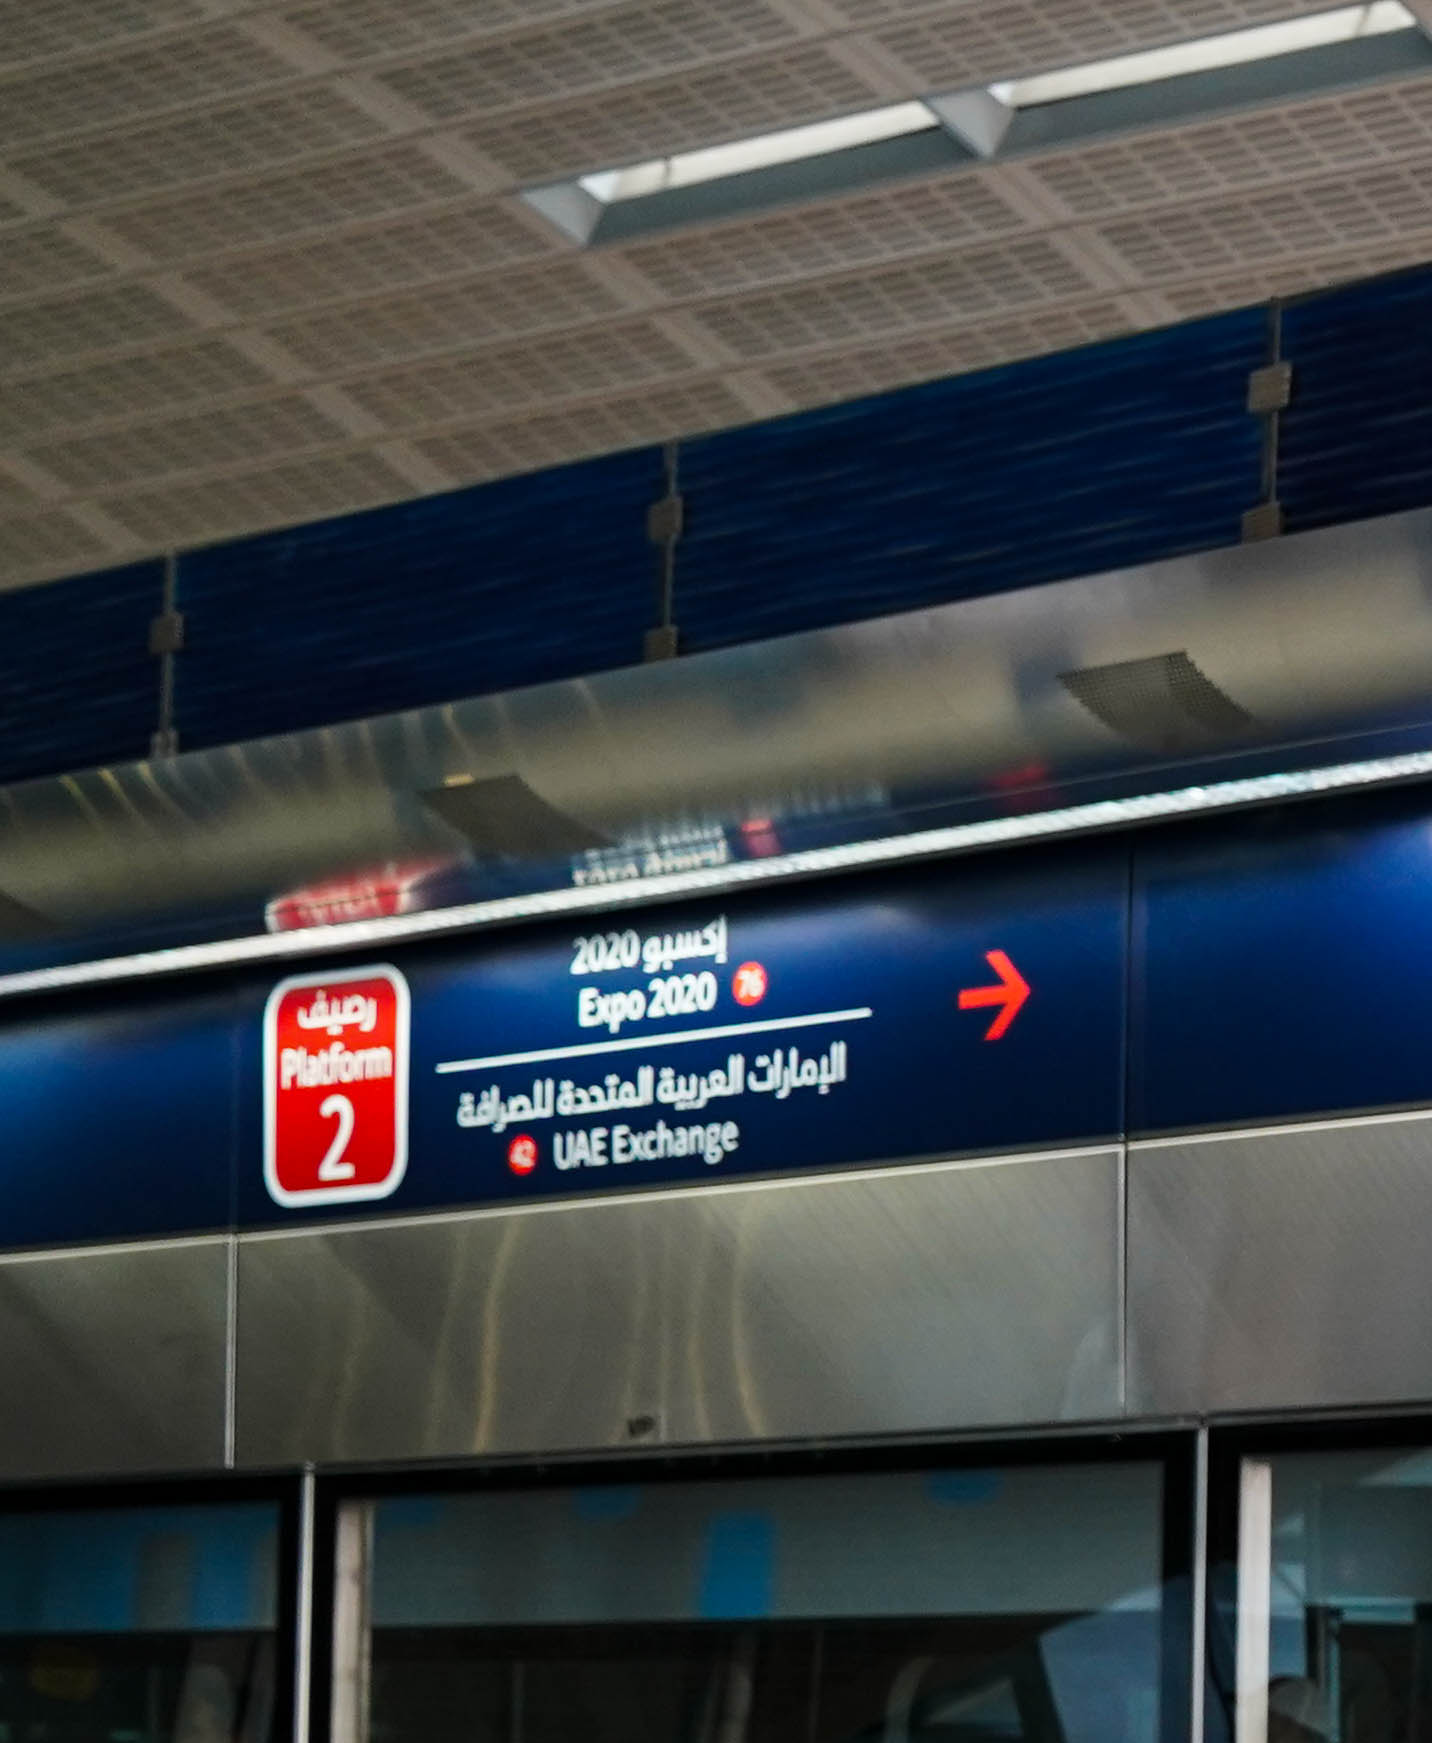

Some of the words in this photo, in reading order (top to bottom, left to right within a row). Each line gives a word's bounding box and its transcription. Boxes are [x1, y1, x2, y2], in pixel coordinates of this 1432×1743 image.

[569, 928, 641, 976] 2020
[641, 912, 728, 974] إكسبو
[296, 989, 378, 1036] رصيف
[578, 986, 647, 1035] Expo
[647, 970, 718, 1019] 2020
[280, 1040, 393, 1091] Platform
[555, 1064, 655, 1117] المتحدة
[655, 1052, 745, 1111] العربية
[455, 1076, 556, 1133] للصرافة
[317, 1093, 356, 1183] 2
[552, 1126, 609, 1171] UAE
[611, 1120, 740, 1166] Exchange
